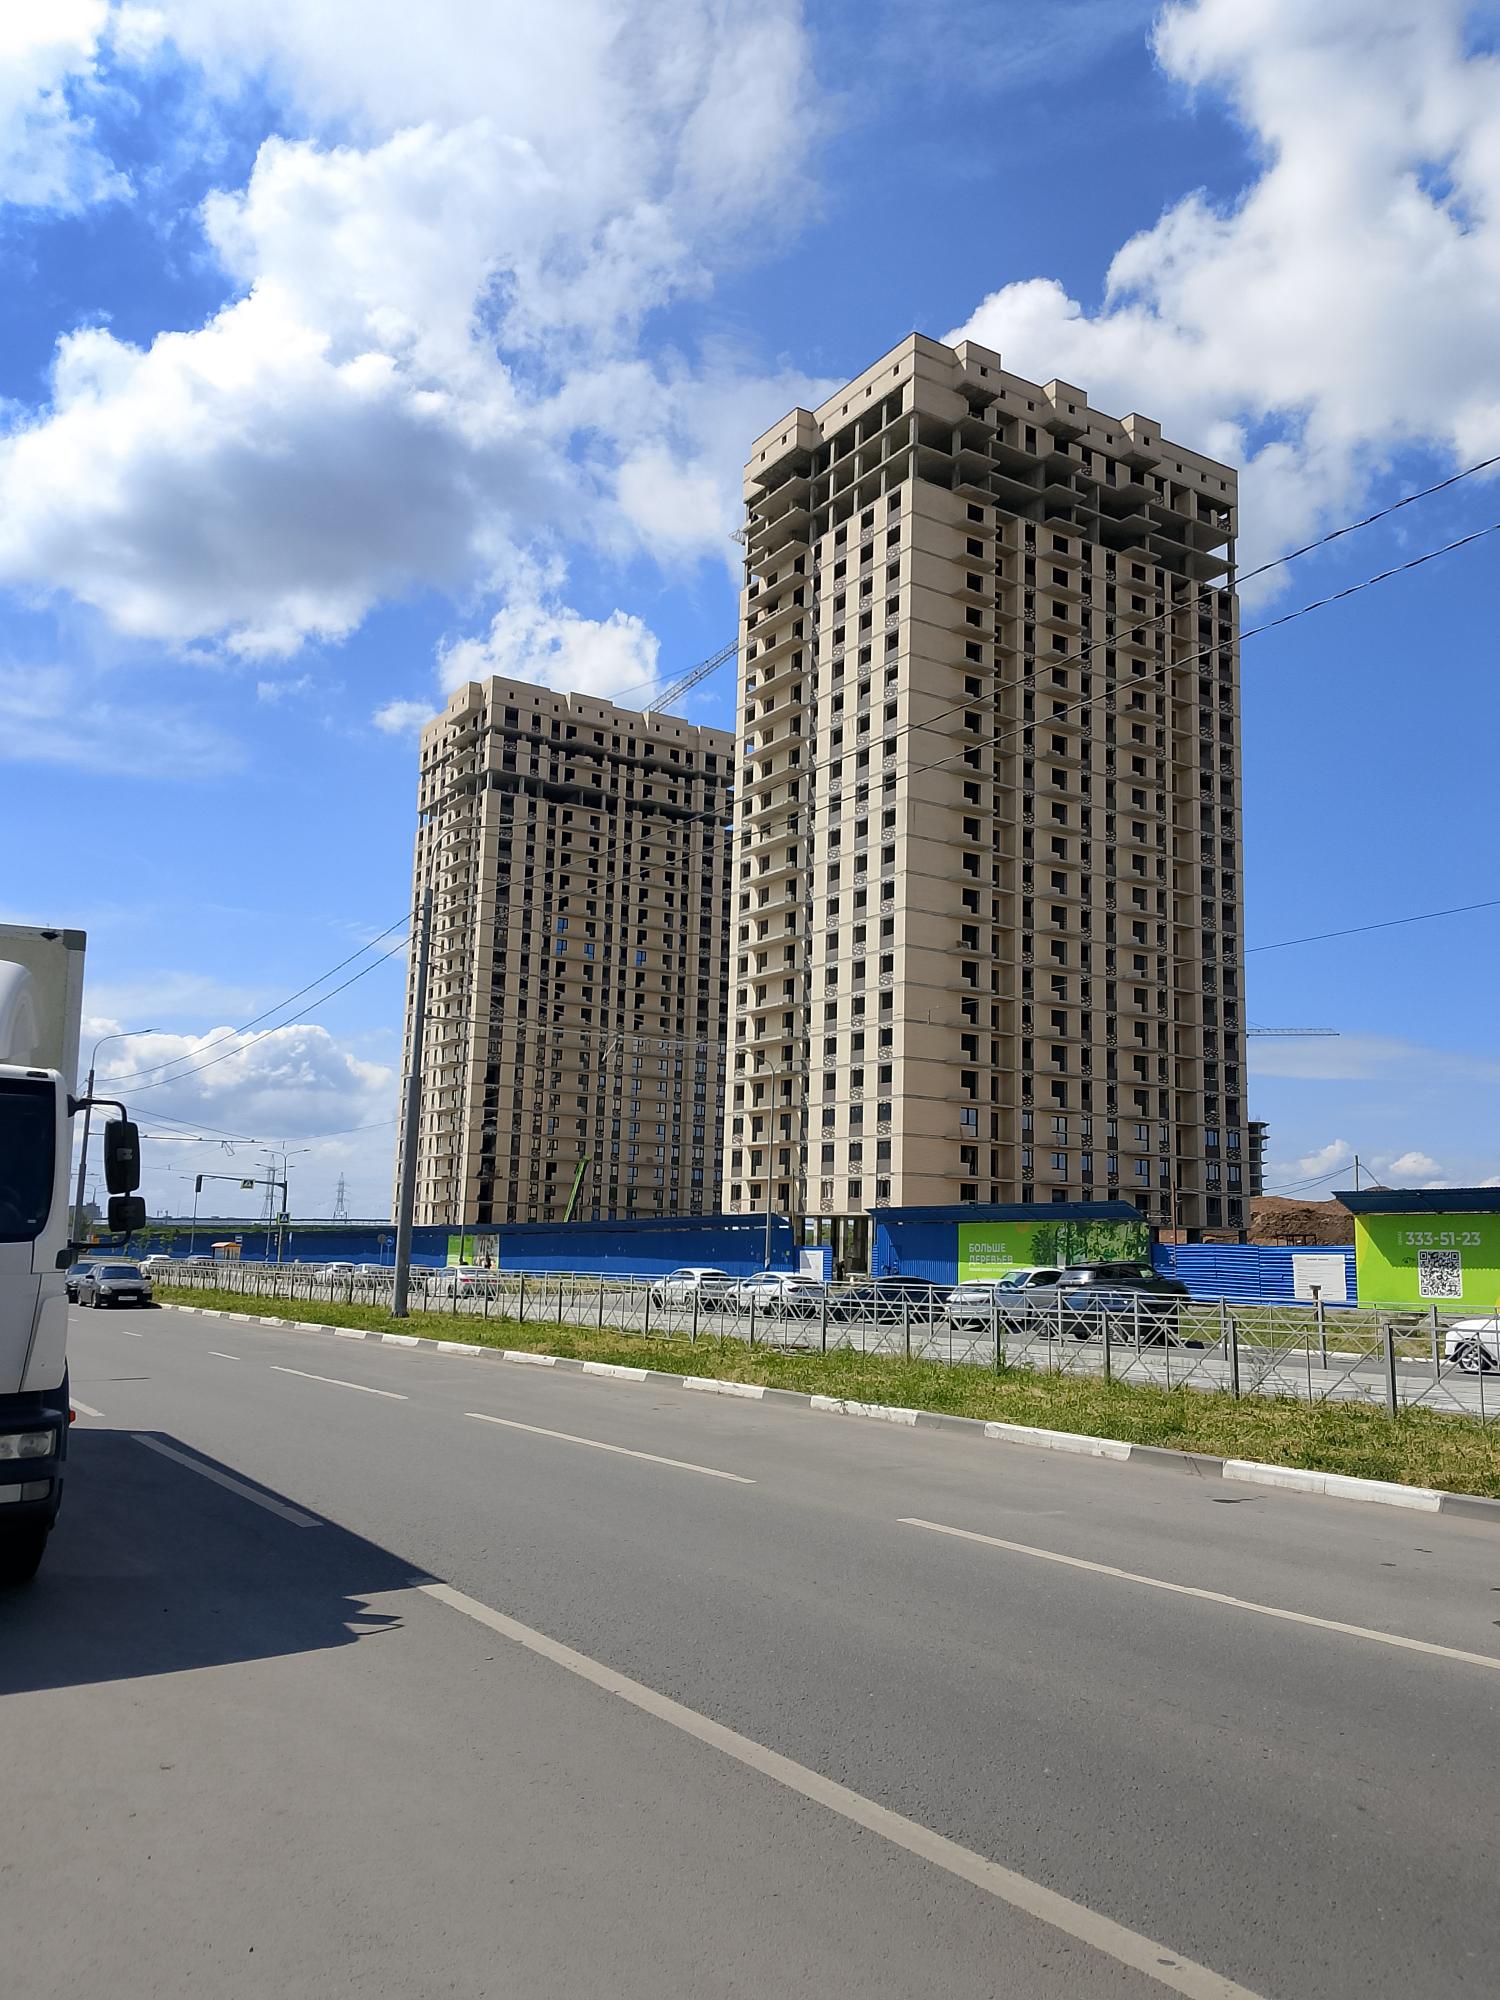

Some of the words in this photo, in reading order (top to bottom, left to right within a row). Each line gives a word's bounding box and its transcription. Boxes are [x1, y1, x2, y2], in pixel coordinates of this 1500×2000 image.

[1405, 1231, 1481, 1246] 333-51-23
[969, 1243, 1006, 1253] БОЛЬШЕ
[969, 1255, 1013, 1266] ДЕРЕВЬЕВ
